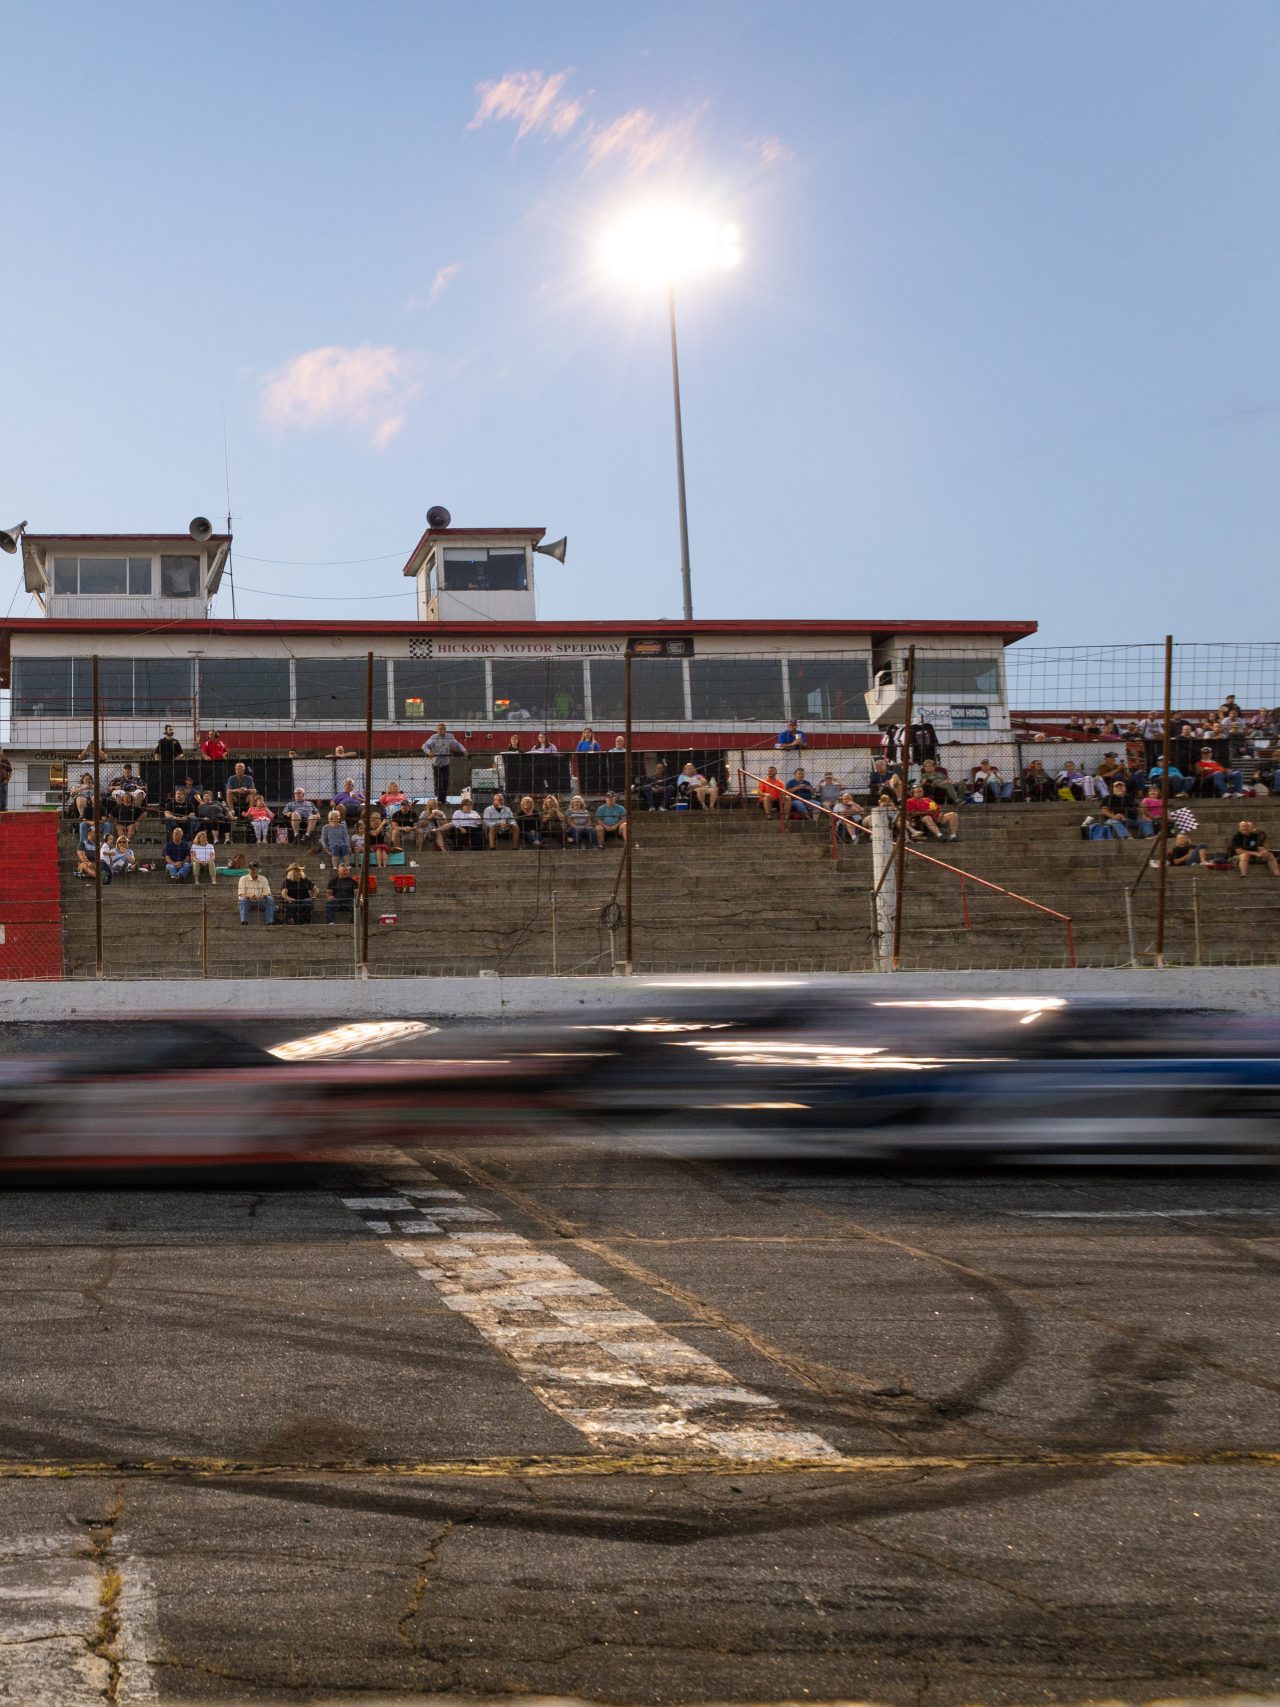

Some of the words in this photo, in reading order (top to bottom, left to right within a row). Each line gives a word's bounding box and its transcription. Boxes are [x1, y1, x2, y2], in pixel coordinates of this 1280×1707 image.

[437, 644, 498, 653] HICKORY
[503, 644, 552, 653] MOTOR
[556, 643, 623, 653] SPEEDWAY
